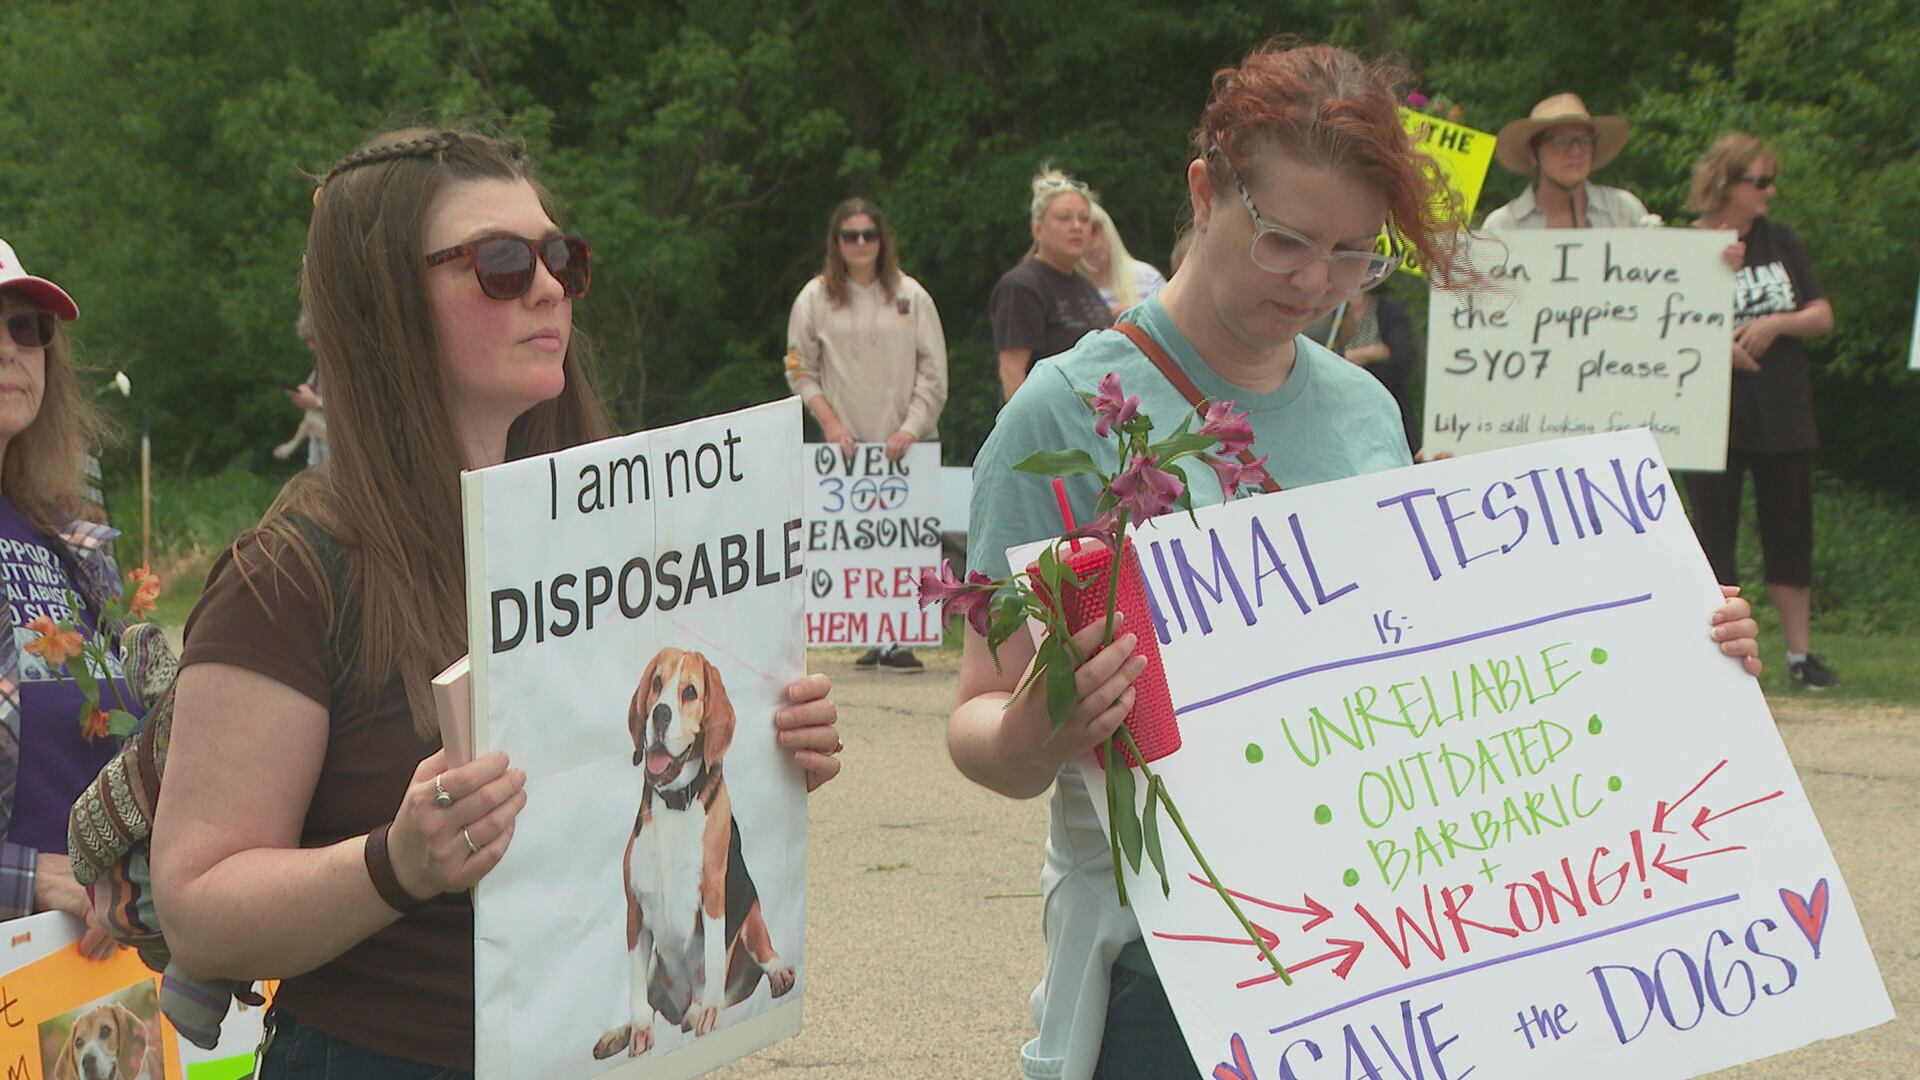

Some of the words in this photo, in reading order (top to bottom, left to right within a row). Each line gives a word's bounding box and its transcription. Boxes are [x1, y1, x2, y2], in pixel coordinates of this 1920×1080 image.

[1425, 121, 1475, 154] THE
[1487, 261, 1531, 282] an
[1552, 243, 1583, 281] I
[1604, 242, 1680, 283] have
[1451, 294, 1508, 329] the
[1533, 300, 1639, 344] puppies
[1657, 292, 1725, 339] from
[1577, 347, 1702, 398] please?
[1434, 413, 1471, 441] Lily
[1477, 415, 1492, 433] is
[1499, 413, 1530, 434] still
[549, 458, 557, 520] I
[577, 454, 651, 514] am
[665, 428, 744, 498] not
[807, 516, 942, 552] EASONS
[1134, 512, 1360, 645] IMAL
[1377, 457, 1666, 581] TESTING
[491, 518, 804, 654] DISPOSABLE
[810, 568, 833, 599] O
[805, 611, 868, 644] HEM
[876, 611, 939, 643] ALL
[1280, 642, 1582, 767] UNRELIABLE
[1358, 719, 1574, 829] OUTDATED
[1366, 773, 1604, 892] BARBARIC
[1354, 829, 1653, 970] WRONG!
[1513, 1002, 1578, 1049] the
[1587, 918, 1797, 1045] DOGS
